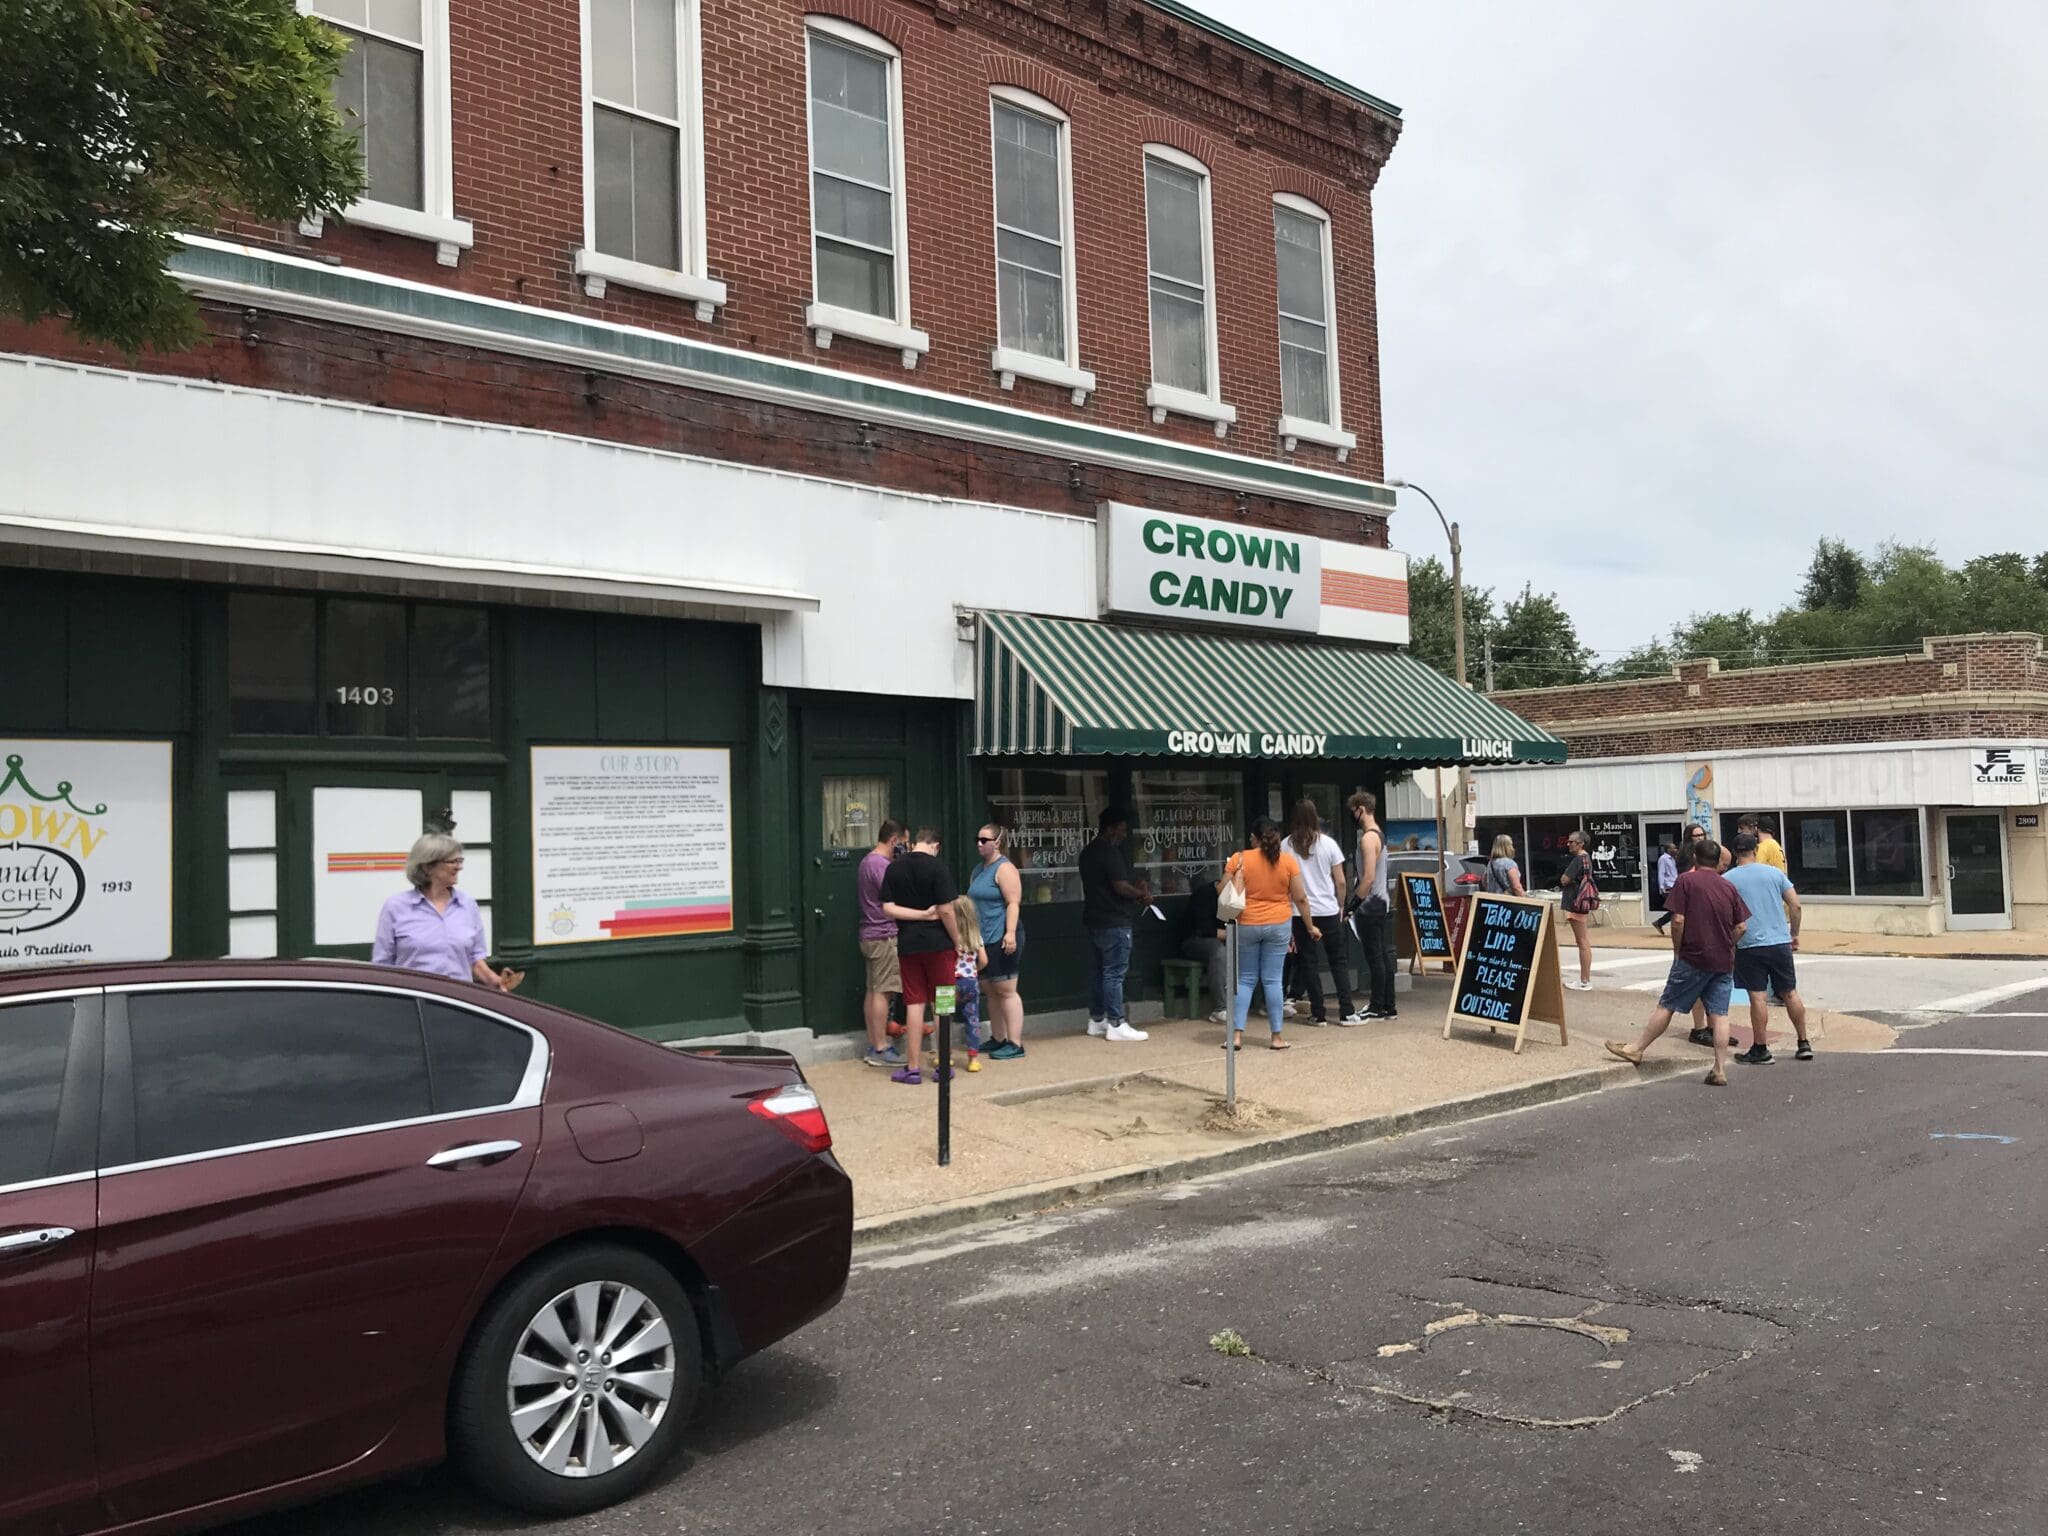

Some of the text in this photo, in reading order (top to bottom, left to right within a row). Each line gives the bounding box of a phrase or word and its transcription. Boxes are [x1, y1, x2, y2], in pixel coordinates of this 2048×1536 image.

[1142, 519, 1300, 574] CROWN
[1149, 571, 1293, 619] CANDY
[336, 686, 394, 705] 1403
[1167, 730, 1513, 758] CROWN CANDY LUNCH
[601, 755, 680, 772] OUR STORY
[1013, 808, 1083, 824] AMERICA'S BEST
[1196, 808, 1227, 822] OLDEST
[2018, 817, 2036, 825] 2800
[1590, 821, 1633, 830] La Mancha
[1007, 824, 1099, 856] WEET TREATS
[1144, 824, 1233, 853] SODA FOUNTAIN
[1032, 850, 1067, 864] & FOOD
[1178, 846, 1207, 859] PARLOR
[101, 881, 132, 893] 1913
[1481, 903, 1512, 928] Take
[24, 942, 92, 956] Tradition
[1475, 966, 1518, 991] PLEASE
[1461, 993, 1512, 1021] OUTSIDE
